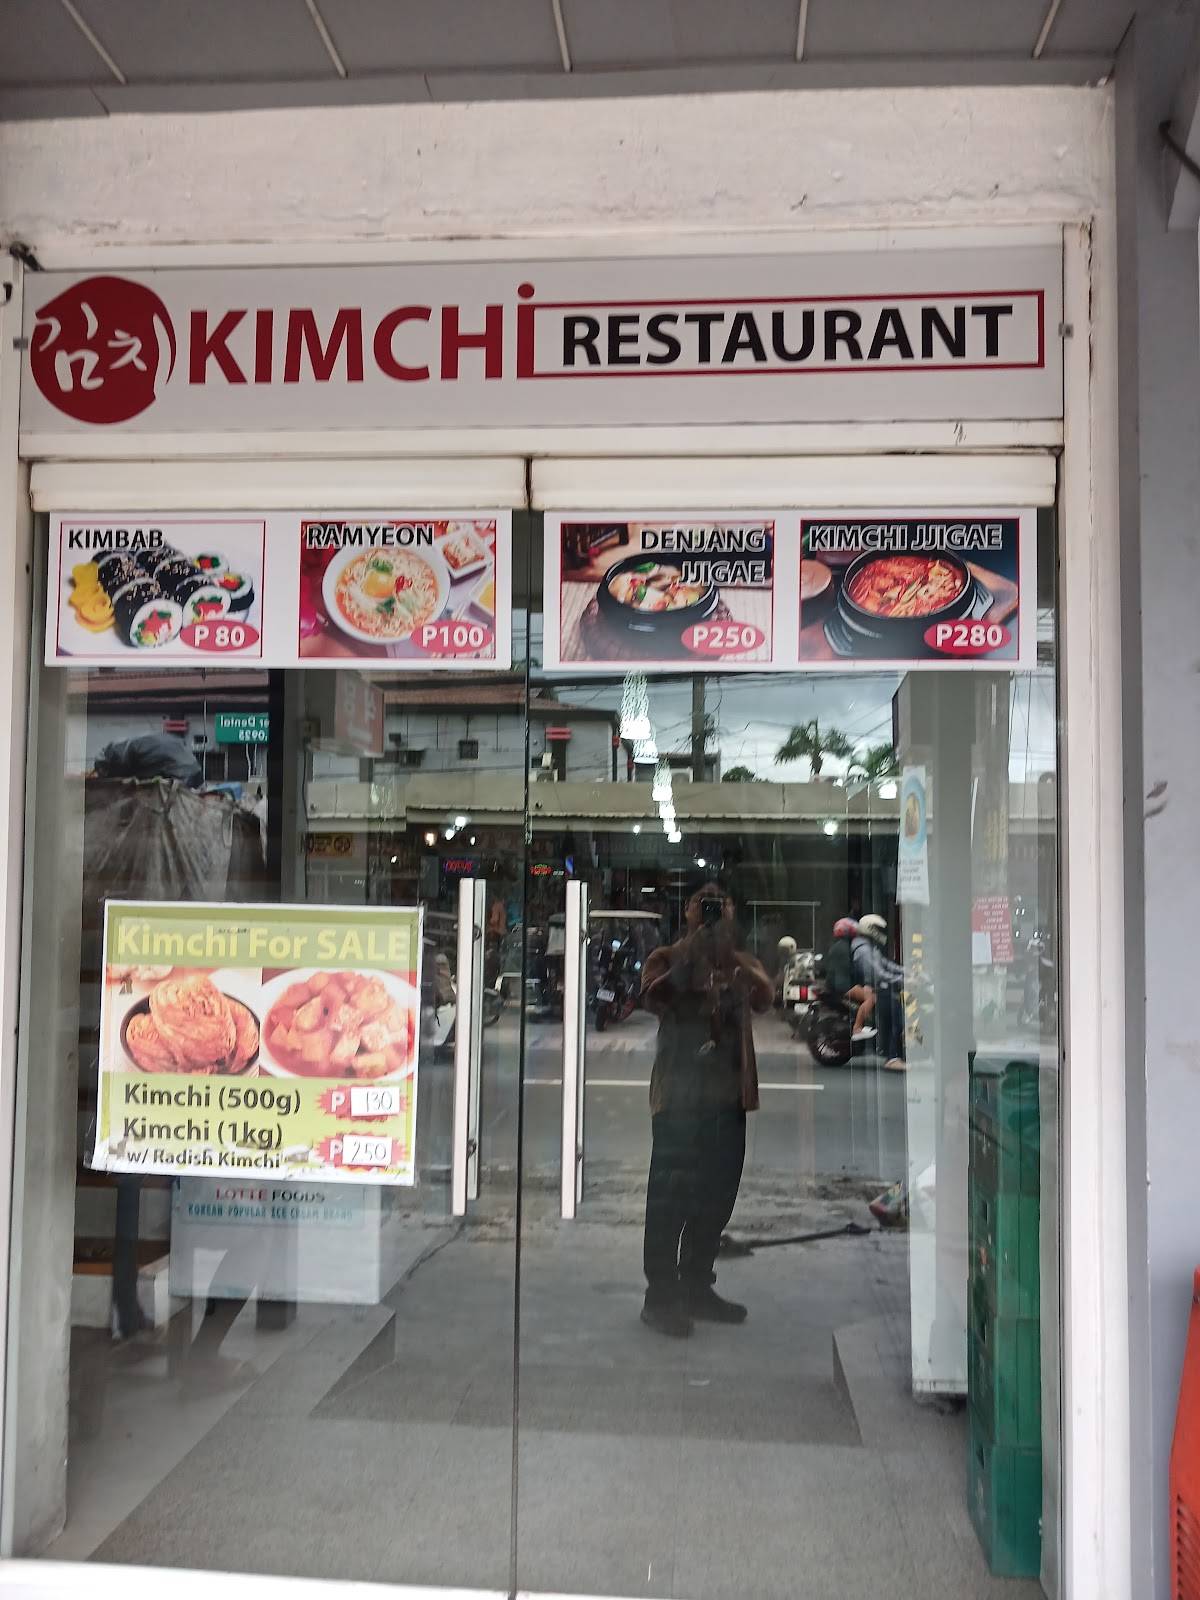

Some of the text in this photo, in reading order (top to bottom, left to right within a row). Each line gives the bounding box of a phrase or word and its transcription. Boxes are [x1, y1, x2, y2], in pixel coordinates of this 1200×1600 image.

[562, 305, 1013, 367] RESTAURANT
[68, 529, 164, 549] KIMBAB
[306, 524, 436, 548] RAMYEON
[640, 529, 765, 551] DENJANG
[810, 524, 1002, 550] KIMCHI JJIGAE
[680, 561, 765, 584] JJIGAE
[194, 625, 245, 648] P 80
[422, 626, 484, 648] P100
[693, 626, 757, 648] P250
[936, 624, 1003, 647] P280
[117, 925, 408, 961] Kimchi For SALE
[124, 1083, 301, 1115] Kimchi (500g)
[331, 1091, 346, 1112] P
[366, 1091, 393, 1112] 130
[123, 1118, 283, 1149] Kimchi (1kg)
[127, 1149, 281, 1169] w/ Radish Kimchi
[329, 1140, 343, 1161] P
[351, 1141, 387, 1162] 250
[216, 1187, 326, 1203] LOTTE FOODS
[188, 1204, 223, 1217] KOREAN
